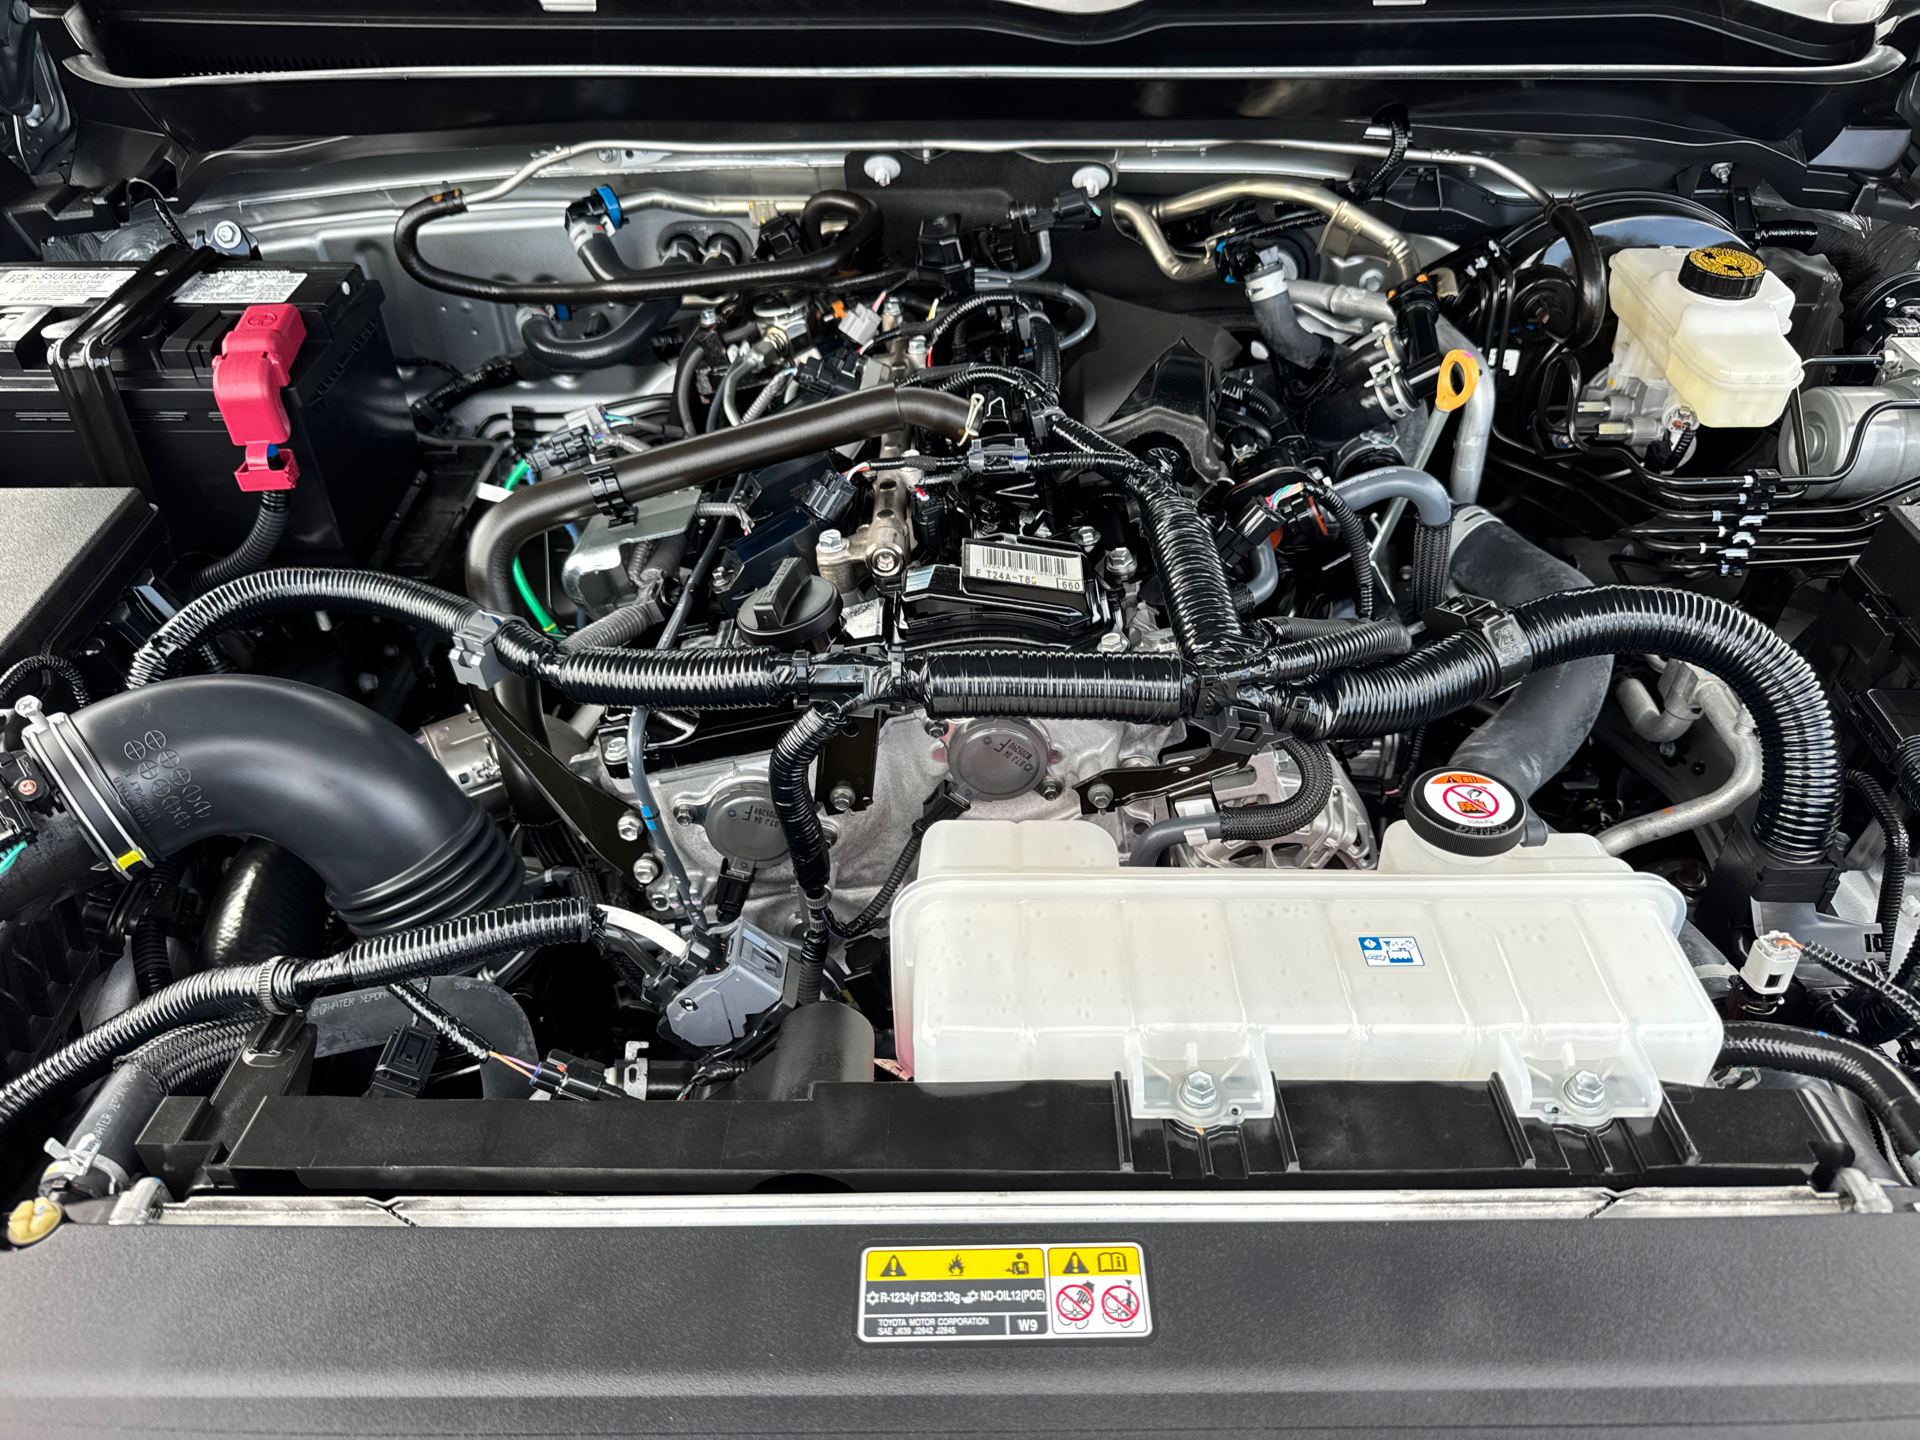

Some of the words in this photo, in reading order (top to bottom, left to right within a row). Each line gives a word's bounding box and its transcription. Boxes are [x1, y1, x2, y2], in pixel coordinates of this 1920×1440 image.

[975, 568, 982, 577] F
[1061, 581, 1080, 591] 660
[993, 739, 1012, 753] F
[742, 805, 754, 822] F
[753, 807, 779, 819] 205289
[1454, 823, 1510, 836] DENSO
[327, 997, 356, 1010] WATER
[880, 1291, 919, 1306] R-1234yf
[920, 1290, 961, 1305] 520±30g
[980, 1289, 1046, 1304] ND-OIL12(POE)
[877, 1318, 907, 1327] TOYOTA
[908, 1318, 936, 1326] MOTOR
[937, 1317, 990, 1326] CORPORATION
[1017, 1318, 1039, 1332] W9
[877, 1327, 894, 1336] SAE
[894, 1327, 912, 1335] J639
